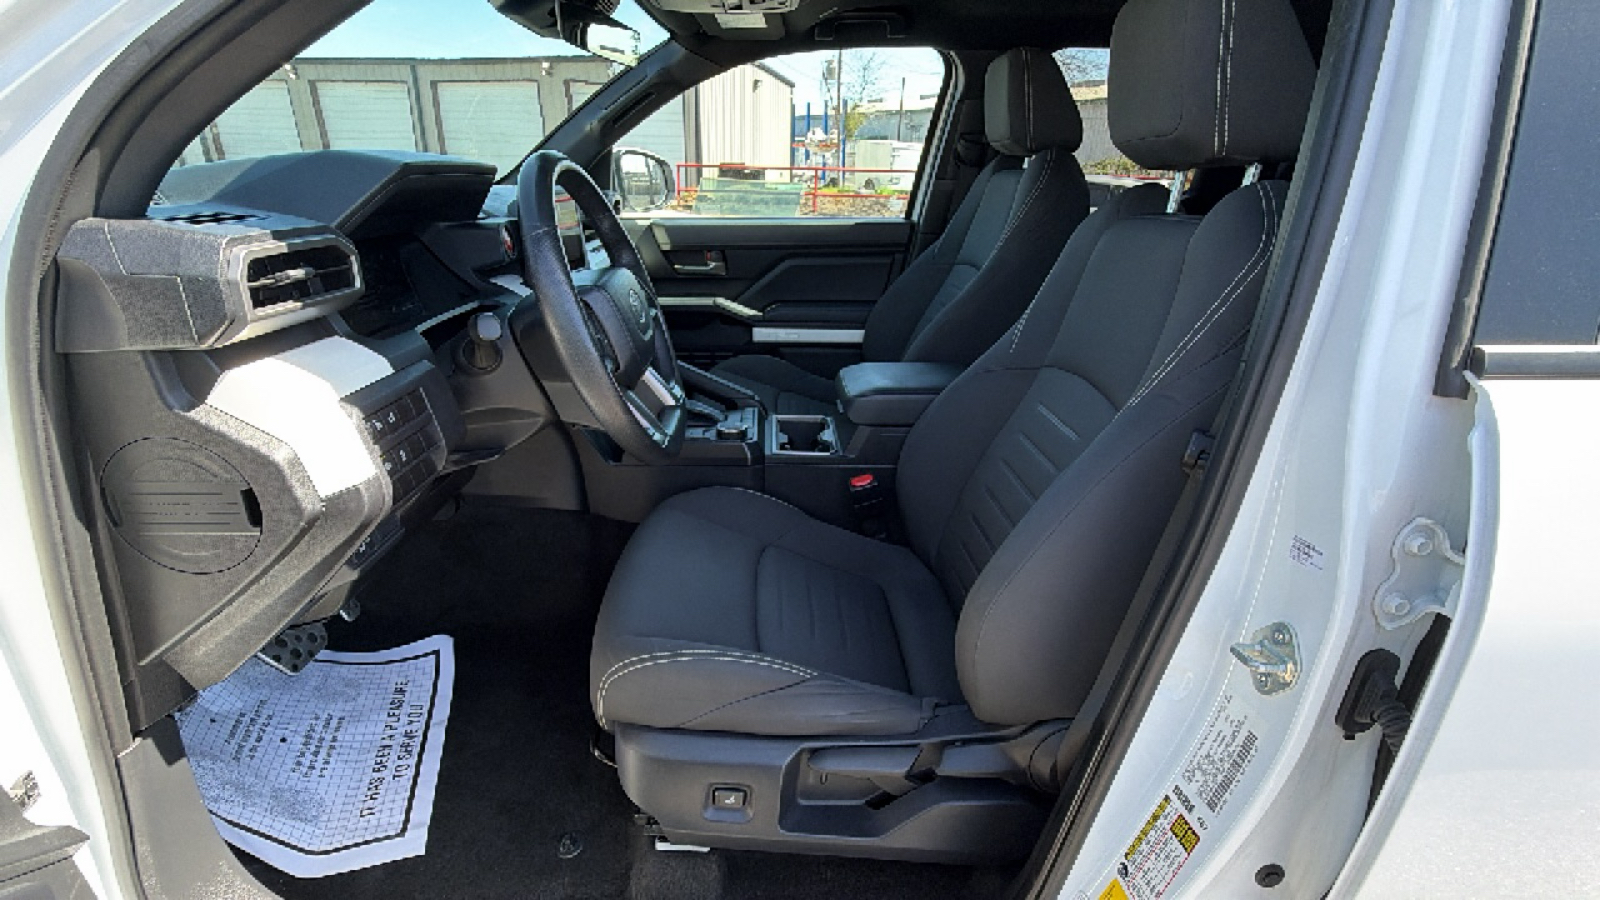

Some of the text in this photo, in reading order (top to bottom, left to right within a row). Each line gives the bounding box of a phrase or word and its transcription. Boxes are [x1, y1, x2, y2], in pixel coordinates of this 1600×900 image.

[383, 679, 409, 729] PLEASURE
[392, 704, 424, 780] TO SERVE YOU
[372, 744, 393, 772] BEEN
[363, 776, 385, 801] HAS
[360, 807, 375, 818] IT
